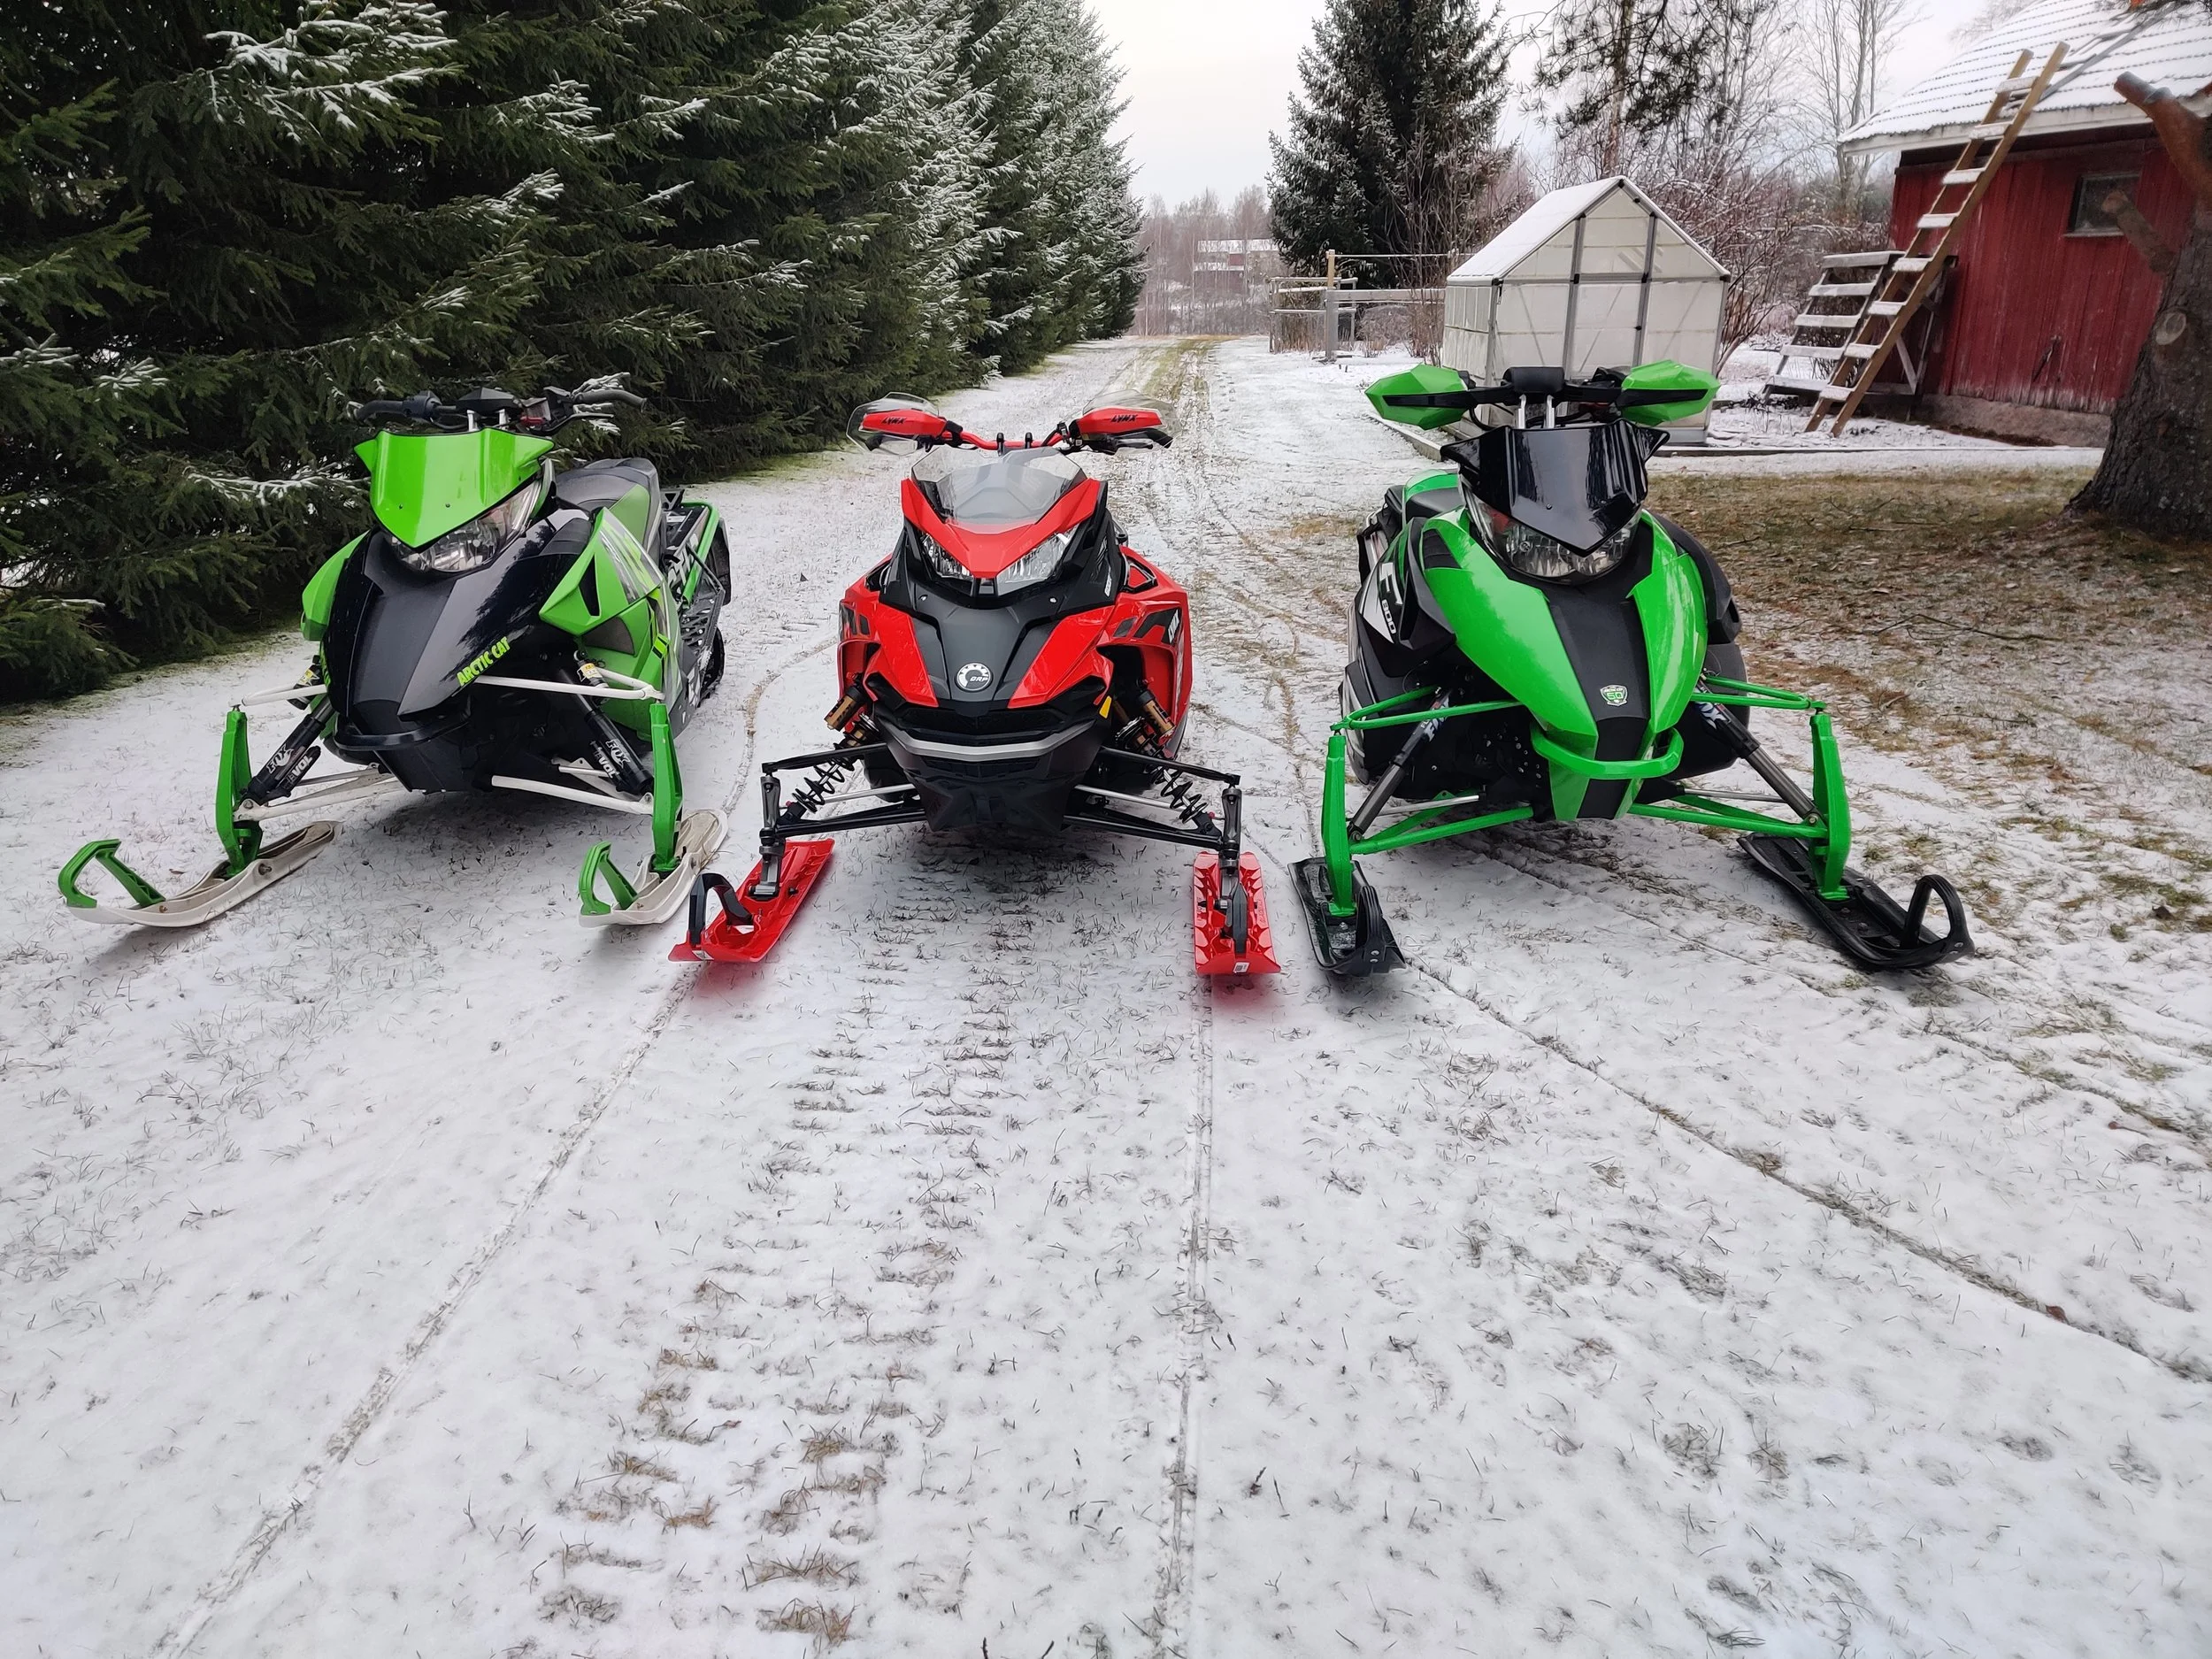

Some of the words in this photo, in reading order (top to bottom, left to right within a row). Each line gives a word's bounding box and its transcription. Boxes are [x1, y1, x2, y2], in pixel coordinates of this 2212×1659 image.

[1110, 414, 1138, 423] LYNX
[1381, 599, 1397, 634] 800
[457, 650, 494, 687] ARCTIC
[491, 636, 511, 658] CAT
[266, 743, 294, 774] FOX
[605, 739, 631, 769] FOX
